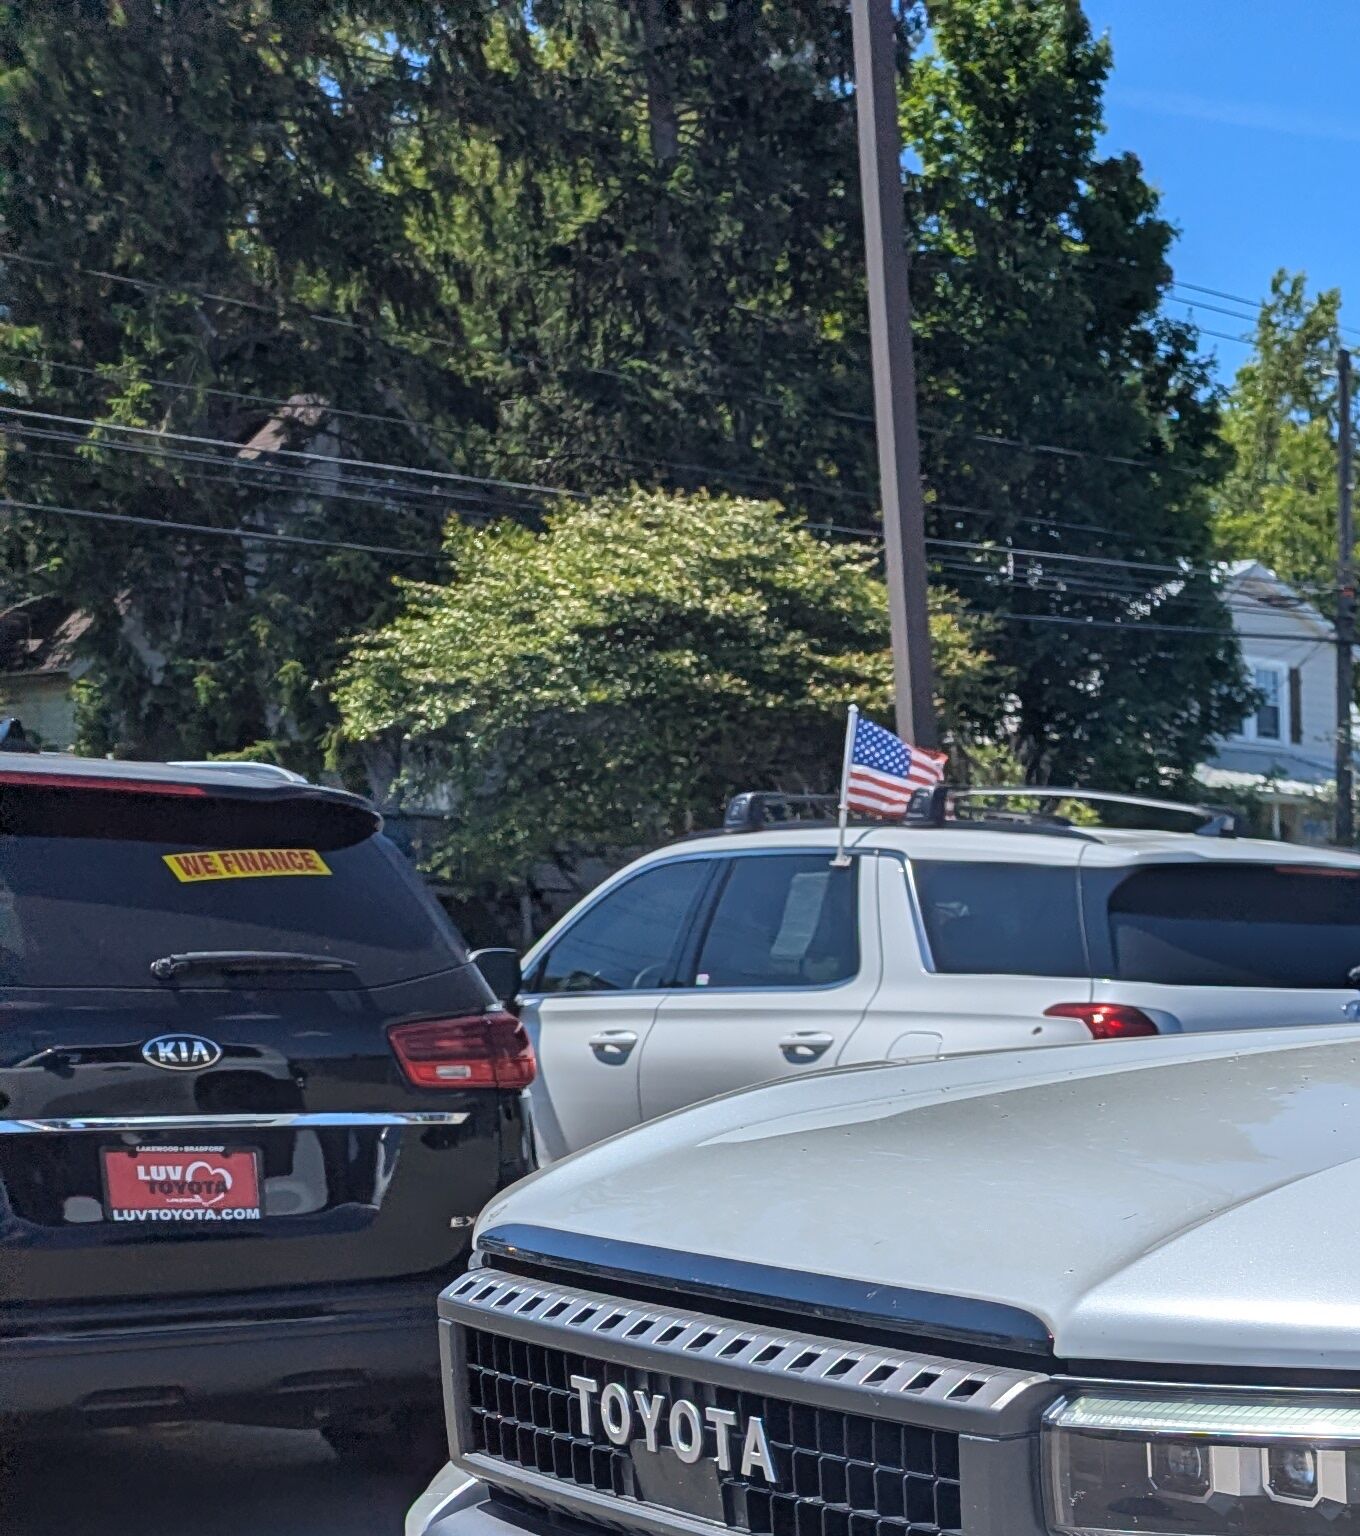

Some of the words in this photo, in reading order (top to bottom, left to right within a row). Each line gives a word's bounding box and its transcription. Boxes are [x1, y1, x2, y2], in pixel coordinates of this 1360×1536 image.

[174, 854, 219, 876] WE
[219, 851, 320, 873] FINANCE
[156, 1041, 211, 1062] KIA
[137, 1165, 183, 1181] LUV
[146, 1180, 230, 1195] TOYOTA
[113, 1208, 261, 1222] LUVTOYOTA.COM
[570, 1374, 778, 1483] TOYOTA
